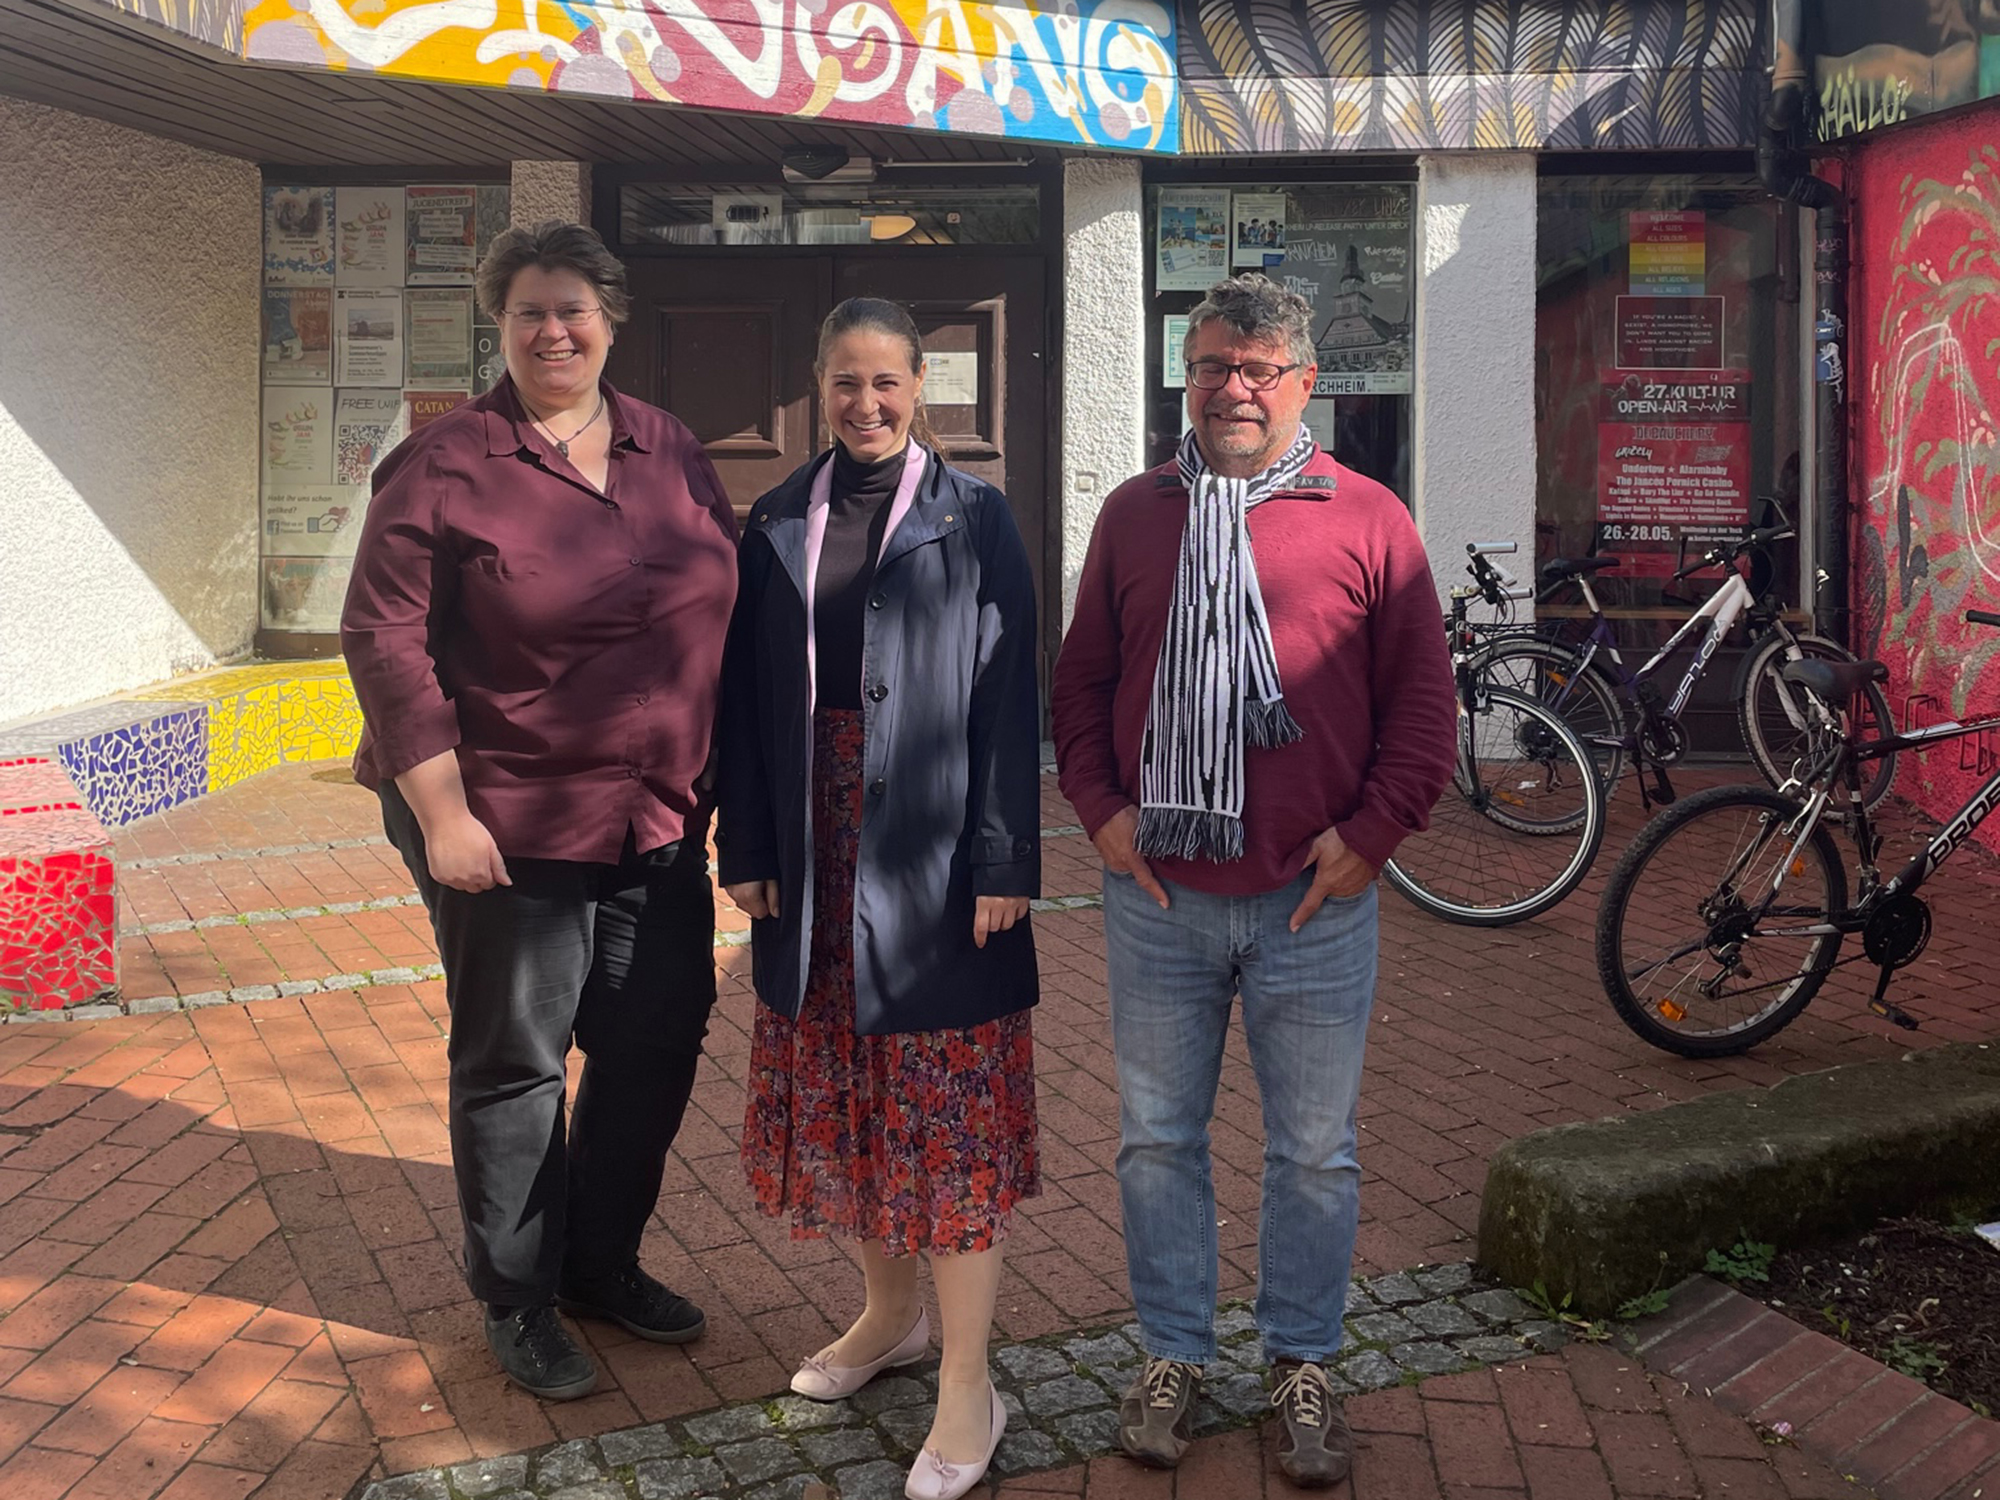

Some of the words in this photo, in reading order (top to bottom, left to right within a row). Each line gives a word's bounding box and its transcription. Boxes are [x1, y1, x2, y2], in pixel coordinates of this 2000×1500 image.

[412, 197, 469, 208] JUGENDTREFF
[1650, 214, 1684, 222] WELCOME
[267, 290, 328, 299] DONNERSTAG
[341, 397, 375, 409] FREE
[377, 399, 401, 410] WIF
[415, 401, 454, 414] CATAN
[1618, 400, 1688, 413] OPEN-AIR
[1622, 464, 1665, 474] Undertow
[1679, 465, 1728, 475] Alarmbaby
[1616, 476, 1632, 485] The
[1666, 477, 1700, 487] Pornick
[1702, 478, 1733, 488] Casino
[1603, 525, 1674, 541] 26.-28.05.
